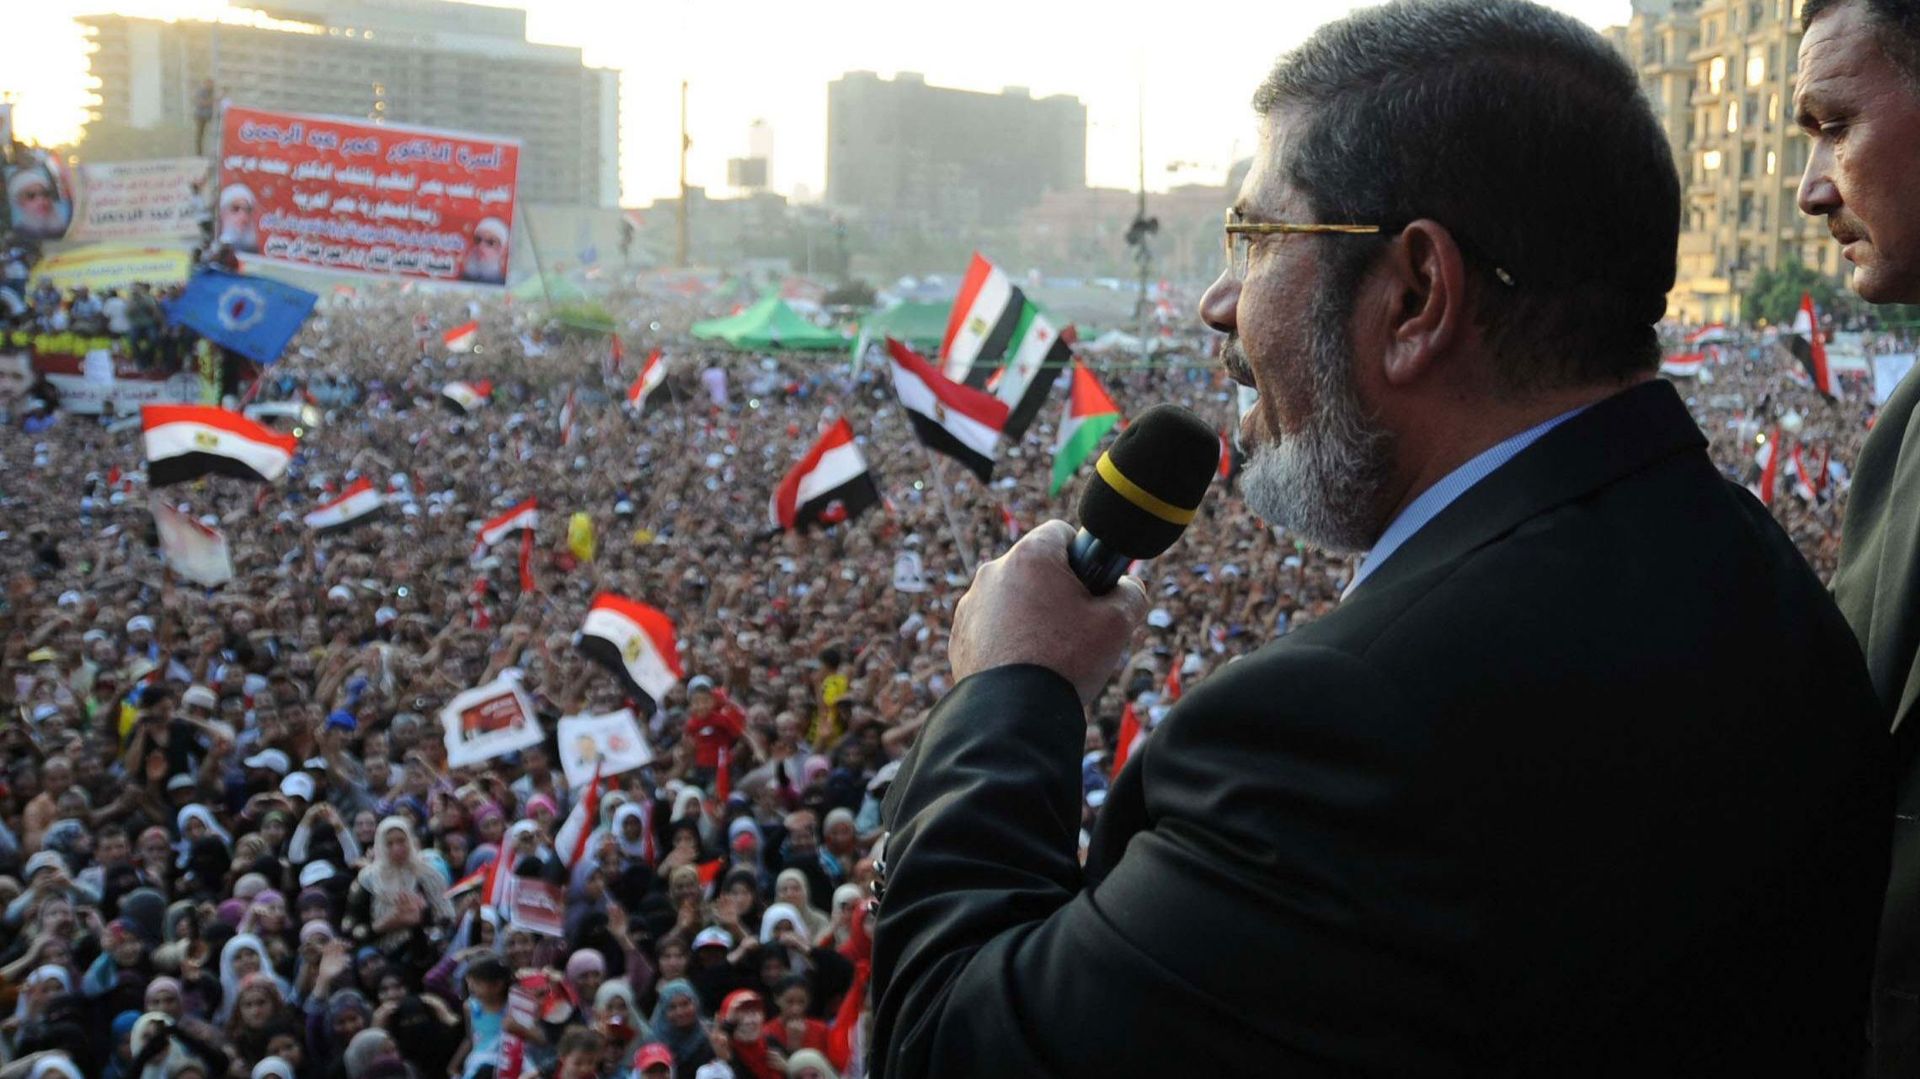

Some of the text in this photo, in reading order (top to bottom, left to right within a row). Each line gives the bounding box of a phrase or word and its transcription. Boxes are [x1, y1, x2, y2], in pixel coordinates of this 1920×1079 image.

[239, 120, 303, 148] الرحمن
[307, 128, 338, 149] عبد
[340, 136, 380, 157] عمر
[387, 138, 452, 164] الدكتور
